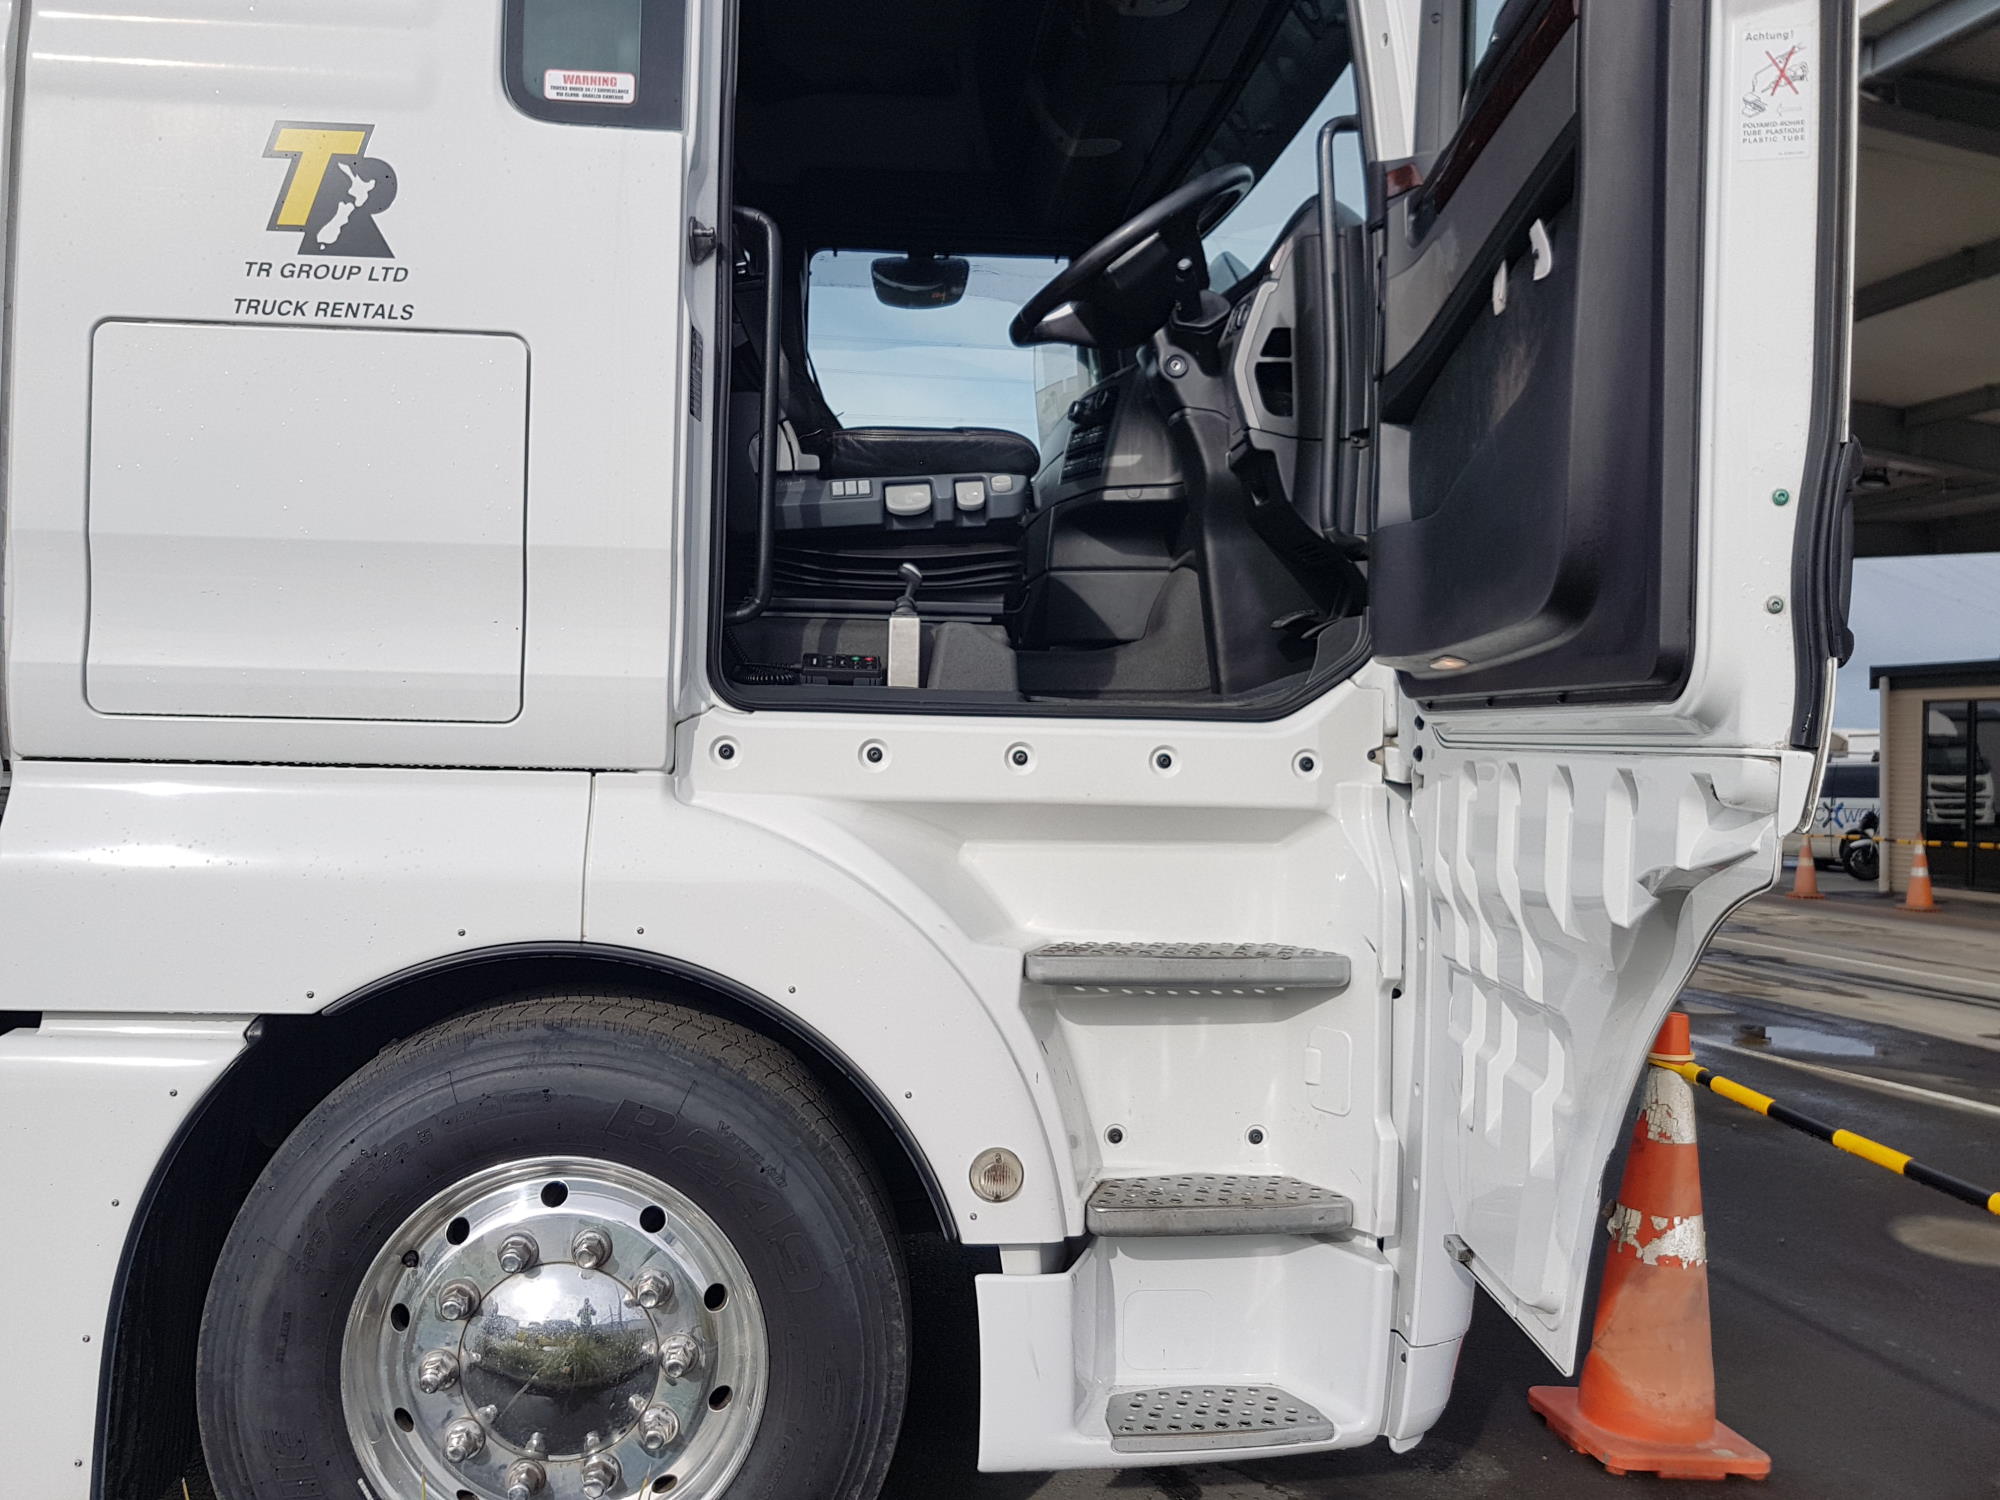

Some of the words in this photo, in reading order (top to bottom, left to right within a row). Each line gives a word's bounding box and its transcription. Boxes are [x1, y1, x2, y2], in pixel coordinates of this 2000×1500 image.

[1745, 30, 1794, 42] Achtung!
[563, 74, 618, 87] WARNING
[1742, 136, 1778, 144] PLASTIC
[1783, 134, 1805, 142] TUBE
[262, 120, 398, 259] TR
[245, 261, 273, 278] TR
[280, 263, 362, 281] GROUP
[368, 267, 409, 283] LTD
[234, 298, 309, 317] TRUCK
[315, 302, 415, 320] RENTALS
